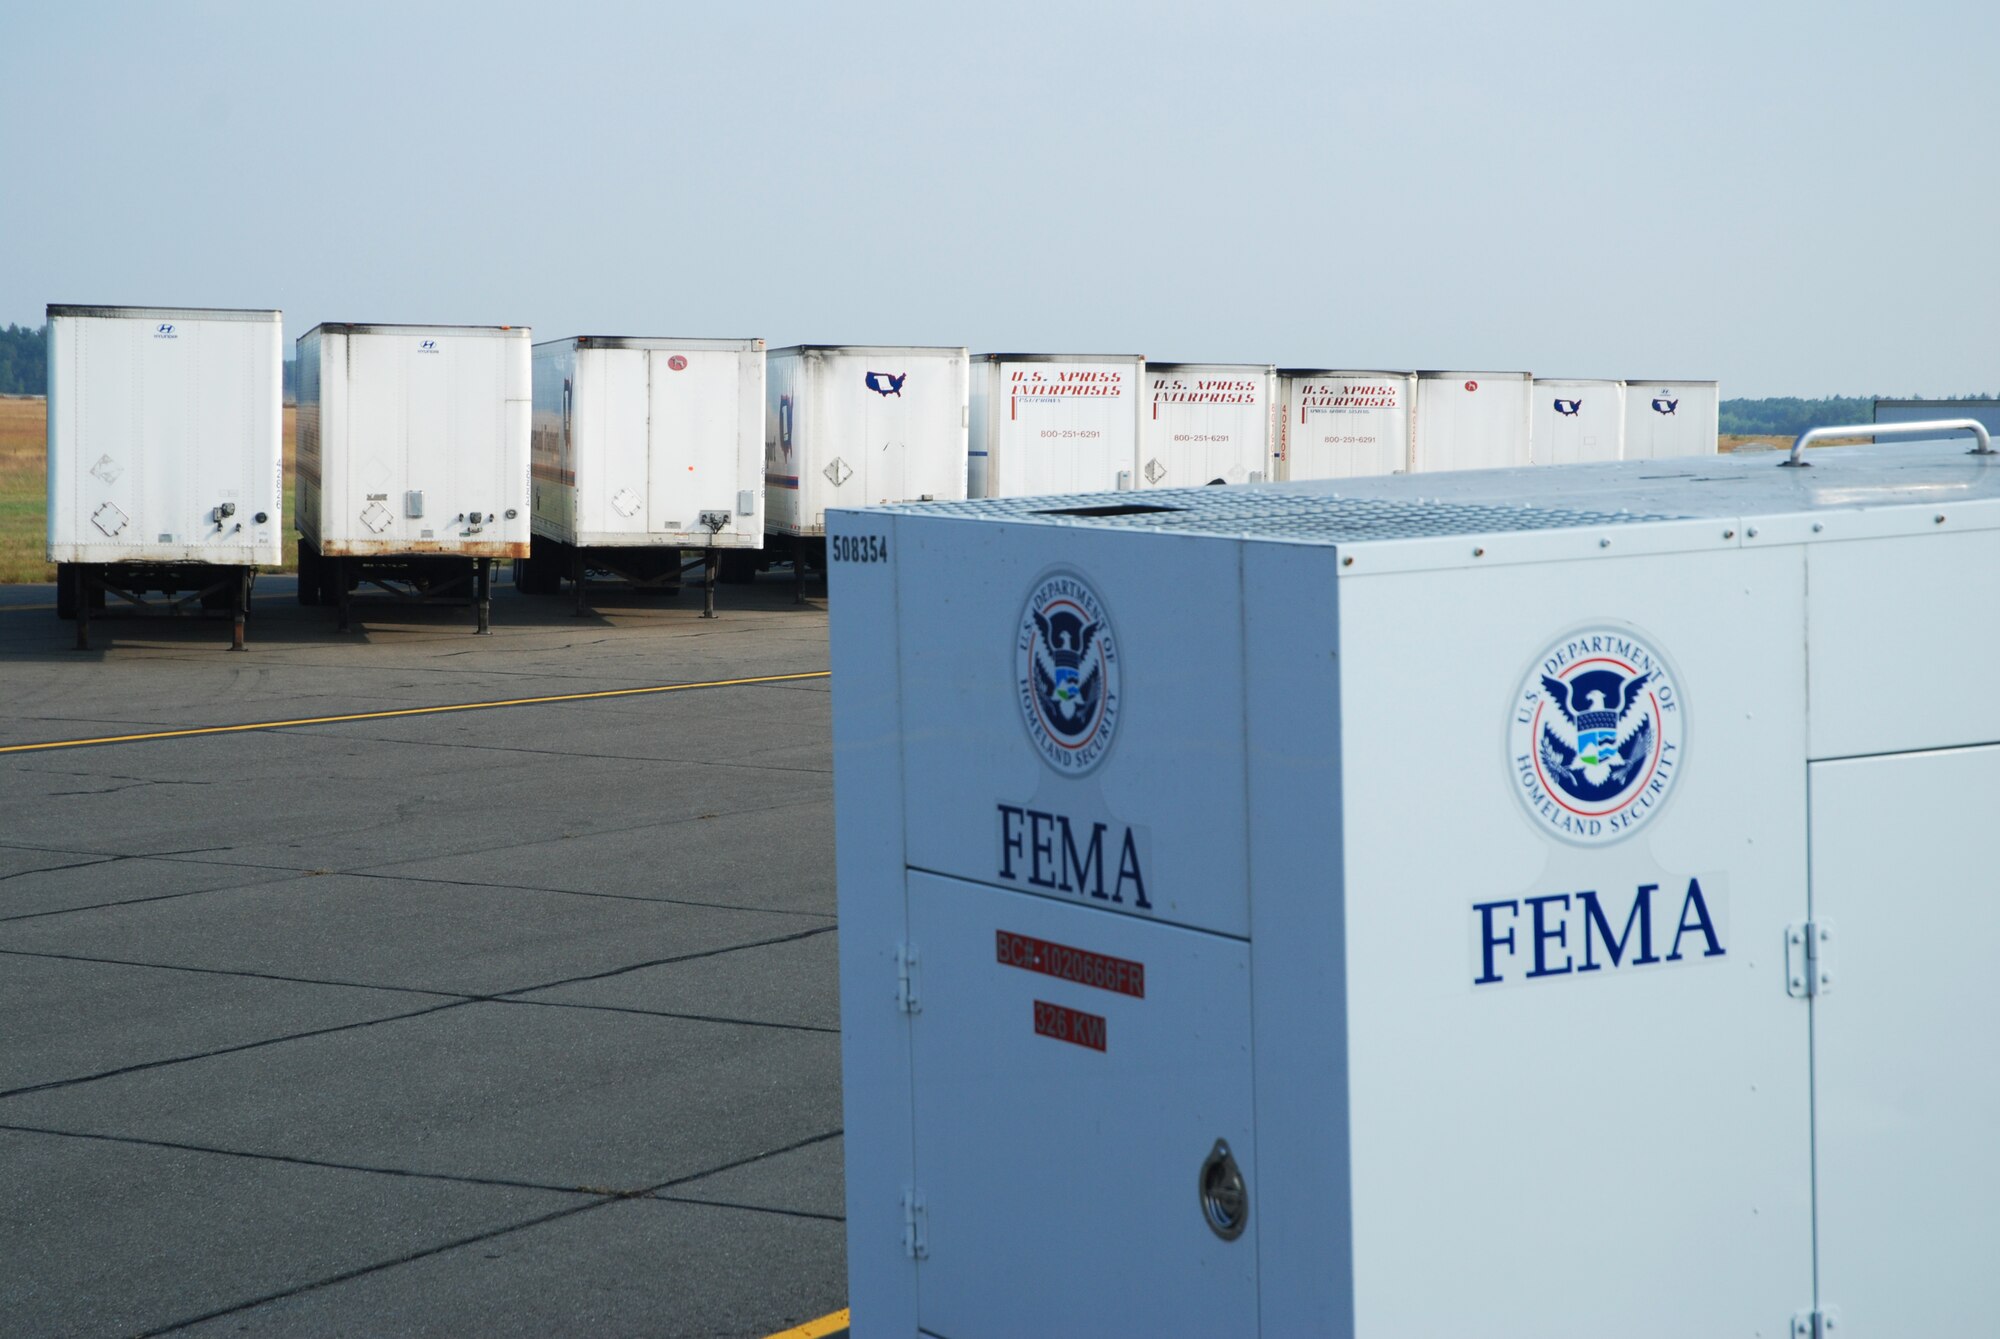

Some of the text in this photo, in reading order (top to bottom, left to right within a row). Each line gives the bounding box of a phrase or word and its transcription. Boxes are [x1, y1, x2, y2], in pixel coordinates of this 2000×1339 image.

[1011, 371, 1122, 382] U.S. XPRESS
[1153, 380, 1256, 391] U.S. XPRESS
[1011, 384, 1122, 396] ENTERPRISES
[1153, 392, 1256, 403] ENTERPRISES
[1302, 385, 1396, 396] U.S. XPRESS
[1302, 396, 1396, 407] ENTERPRISES
[1040, 430, 1101, 438] 800-251-6291
[1174, 434, 1230, 442] 800-251-6291
[833, 534, 888, 563] 508354
[1034, 579, 1108, 632] DEPARTMENT
[1103, 636, 1115, 664] OF
[1544, 635, 1665, 684] DEPARTMENT
[1658, 686, 1676, 713] OF
[1019, 678, 1117, 768] HOMELAND SECURITY
[1517, 741, 1677, 836] HOMELAND SECURITY
[997, 803, 1152, 910] FEMA
[1472, 877, 1727, 986] FEMA
[1035, 1003, 1106, 1049] 326 KW
